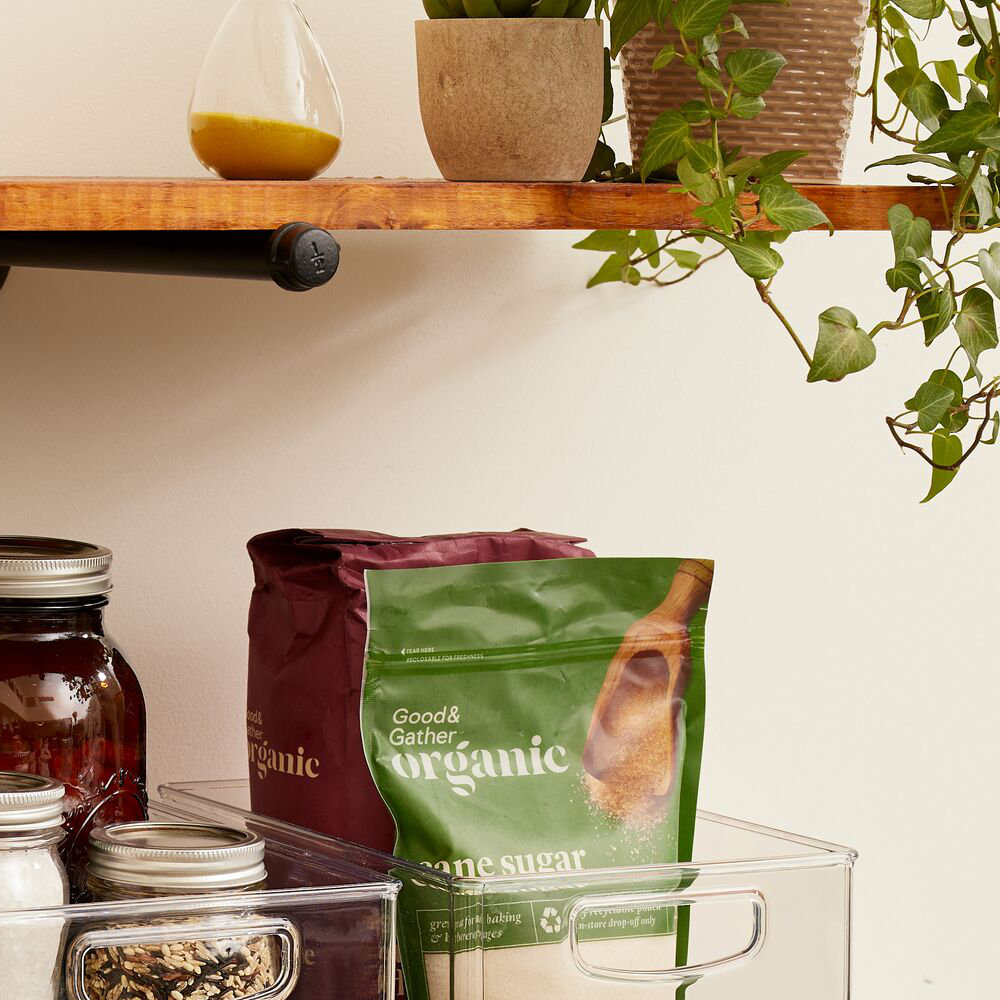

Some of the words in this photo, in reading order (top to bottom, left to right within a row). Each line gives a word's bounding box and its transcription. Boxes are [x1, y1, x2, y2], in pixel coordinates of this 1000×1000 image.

[389, 727, 458, 746] Gather
[391, 735, 569, 796] organic
[486, 911, 522, 926] baking
[641, 915, 656, 927] only
